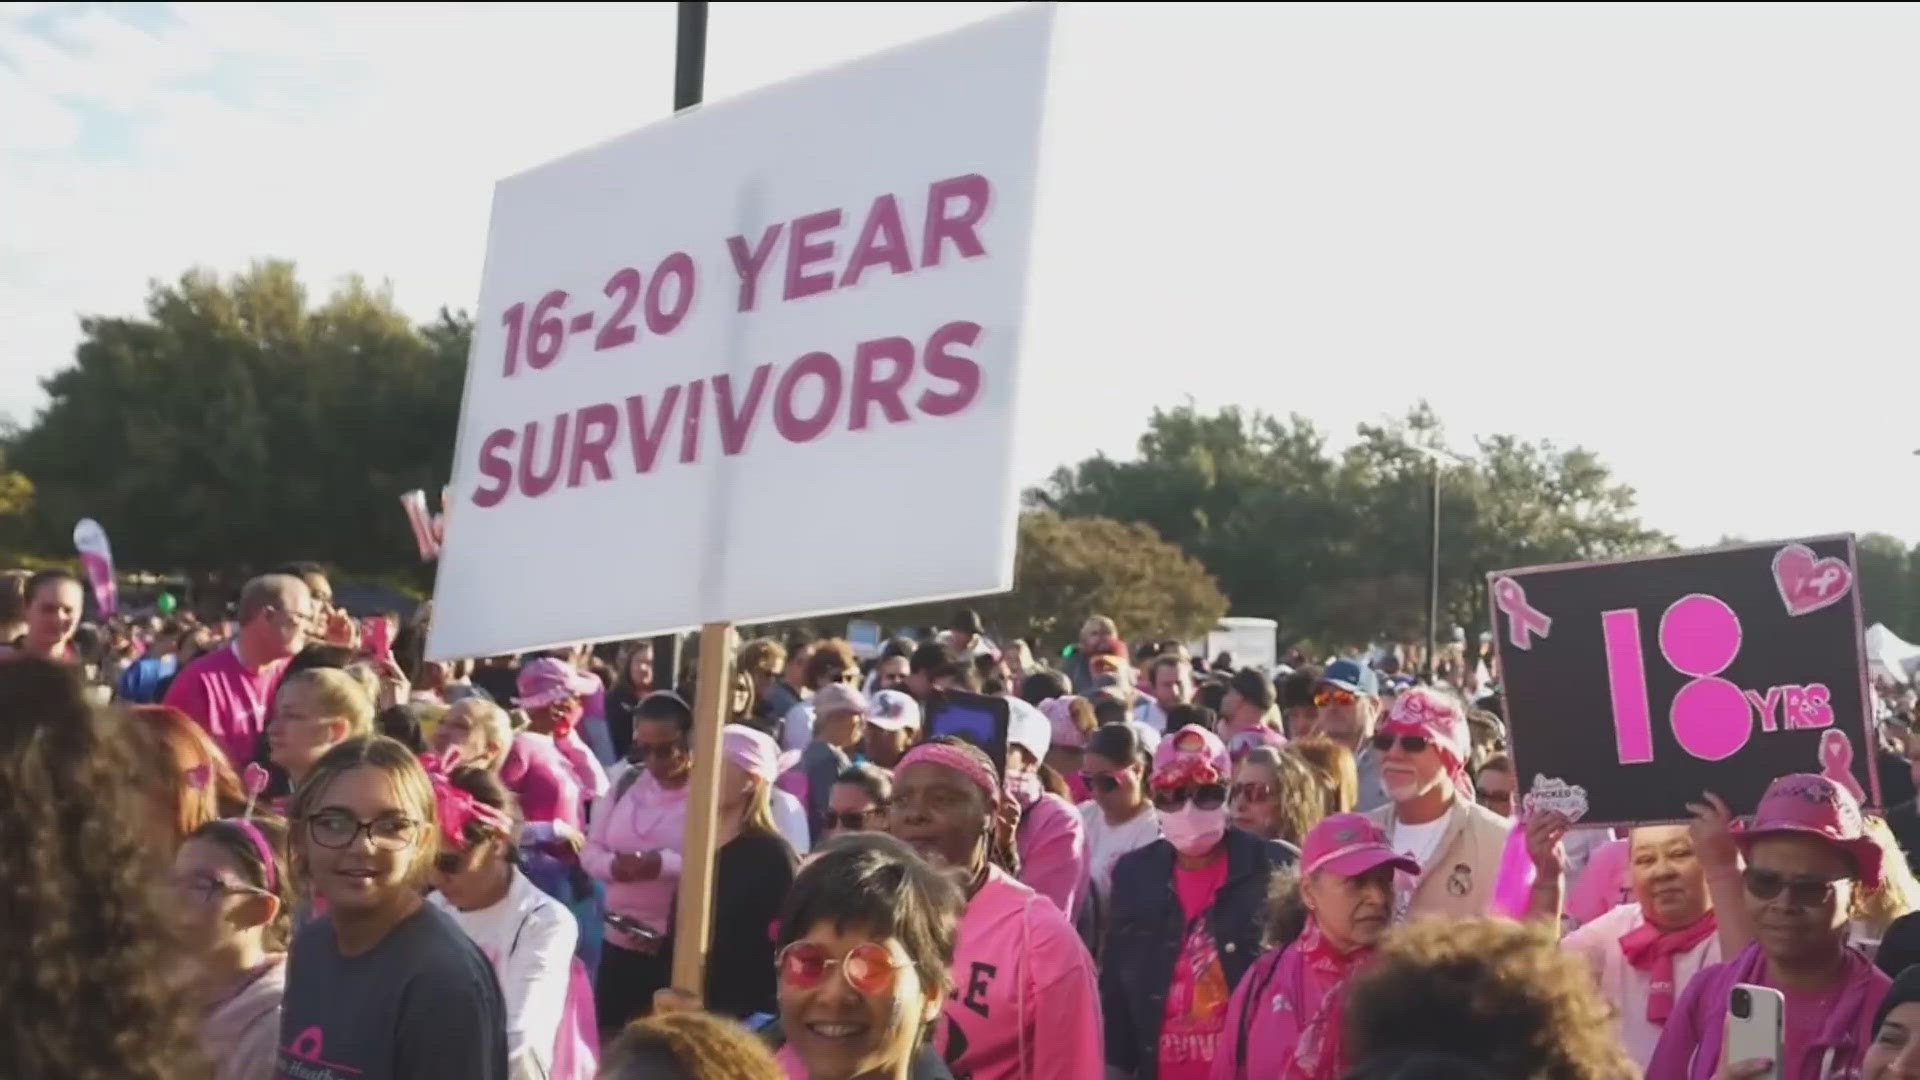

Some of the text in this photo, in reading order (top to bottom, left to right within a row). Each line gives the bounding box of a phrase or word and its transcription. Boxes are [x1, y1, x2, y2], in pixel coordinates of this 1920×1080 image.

[502, 173, 991, 378] 16-20 YEAR
[471, 320, 983, 508] SURVIVORS
[1600, 593, 1834, 764] 18 YRS
